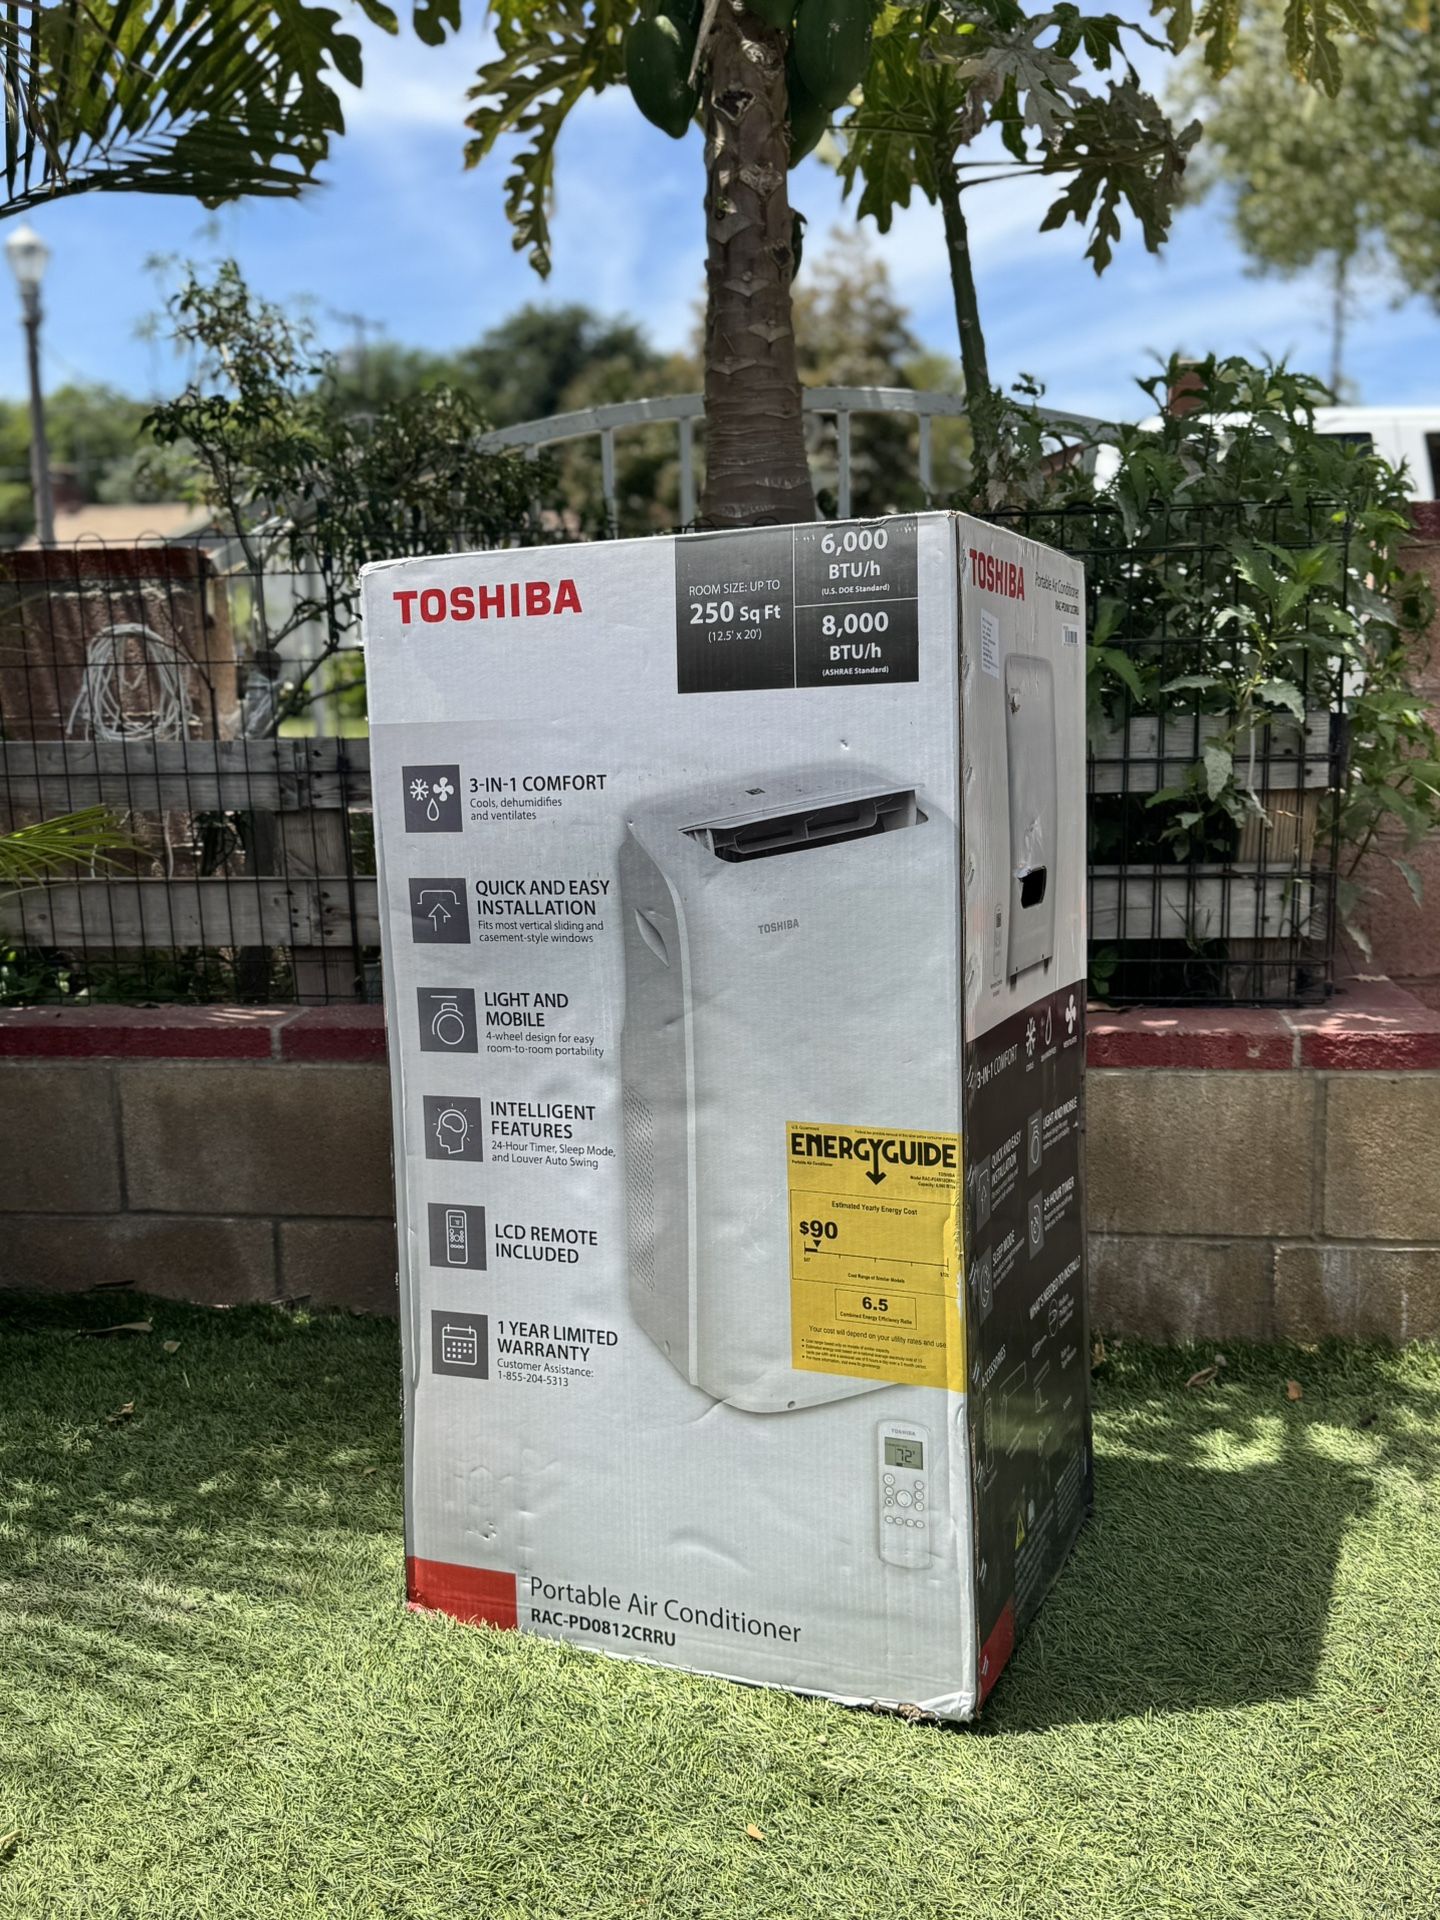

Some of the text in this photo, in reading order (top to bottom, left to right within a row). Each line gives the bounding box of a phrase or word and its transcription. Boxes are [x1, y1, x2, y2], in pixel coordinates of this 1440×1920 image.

[821, 529, 888, 556] 6,000
[829, 561, 880, 579] BTU/h
[970, 548, 1024, 600] TOSHIBA
[689, 580, 780, 596] ROOM SIZE: UP TO
[822, 584, 890, 596] (U.S. DOE Standard)
[392, 579, 583, 624] TOSHIBA
[690, 601, 781, 624] 250 Sq Ft
[822, 612, 889, 638] 8,000
[736, 632, 742, 640] x
[830, 643, 881, 660] BTU/h
[822, 666, 889, 677] (ASHRAE Standard)
[469, 774, 607, 793] 3-IN-1 COMFORT
[470, 797, 562, 808] Cools, dehumidifies
[471, 811, 536, 820] and ventilates
[476, 880, 610, 896] QUICK AND EASY
[477, 900, 596, 915] INSTALLATION
[478, 921, 603, 933] Fits most vertical sliding and
[758, 918, 800, 934] TOSHIBA
[479, 933, 594, 944] casement-style windows
[484, 992, 569, 1008] LIGHT AND
[486, 1012, 545, 1027] MOBILE
[486, 1032, 594, 1045] 4-wheel design for easy
[487, 1045, 604, 1058] room-to-room portability
[977, 1062, 993, 1088] 3-IN-1
[994, 1044, 1018, 1075] COMFORT
[490, 1101, 596, 1120] INTELLIGENT
[491, 1121, 573, 1138] FEATURES
[491, 1141, 616, 1158] 24-Hour Timer, Sleep Mode,
[791, 1133, 957, 1169] ENERGYGUIDE
[491, 1153, 599, 1170] and Louver Auto Swing
[832, 1201, 860, 1210] Estimated
[862, 1204, 879, 1213] Yearly
[881, 1206, 902, 1215] Energy
[495, 1224, 598, 1246] LCD REMOTE
[799, 1220, 838, 1239] $90
[496, 1243, 579, 1264] INCLUDED
[862, 1296, 888, 1311] 6.5
[498, 1320, 618, 1346] 1 YEAR LIMITED
[809, 1325, 822, 1333] Your
[823, 1327, 835, 1335] cost
[836, 1328, 845, 1336] will
[848, 1330, 867, 1339] depend
[877, 1334, 890, 1342] your
[891, 1335, 906, 1345] utility
[907, 1337, 922, 1346] rates
[497, 1338, 590, 1362] WARRANTY
[497, 1358, 594, 1378] Customer Assistance:
[498, 1371, 569, 1386] 1-855-204-5313
[530, 1576, 802, 1642] Portable Air Conditioner
[531, 1609, 676, 1646] RAC-PD0812CRRU
